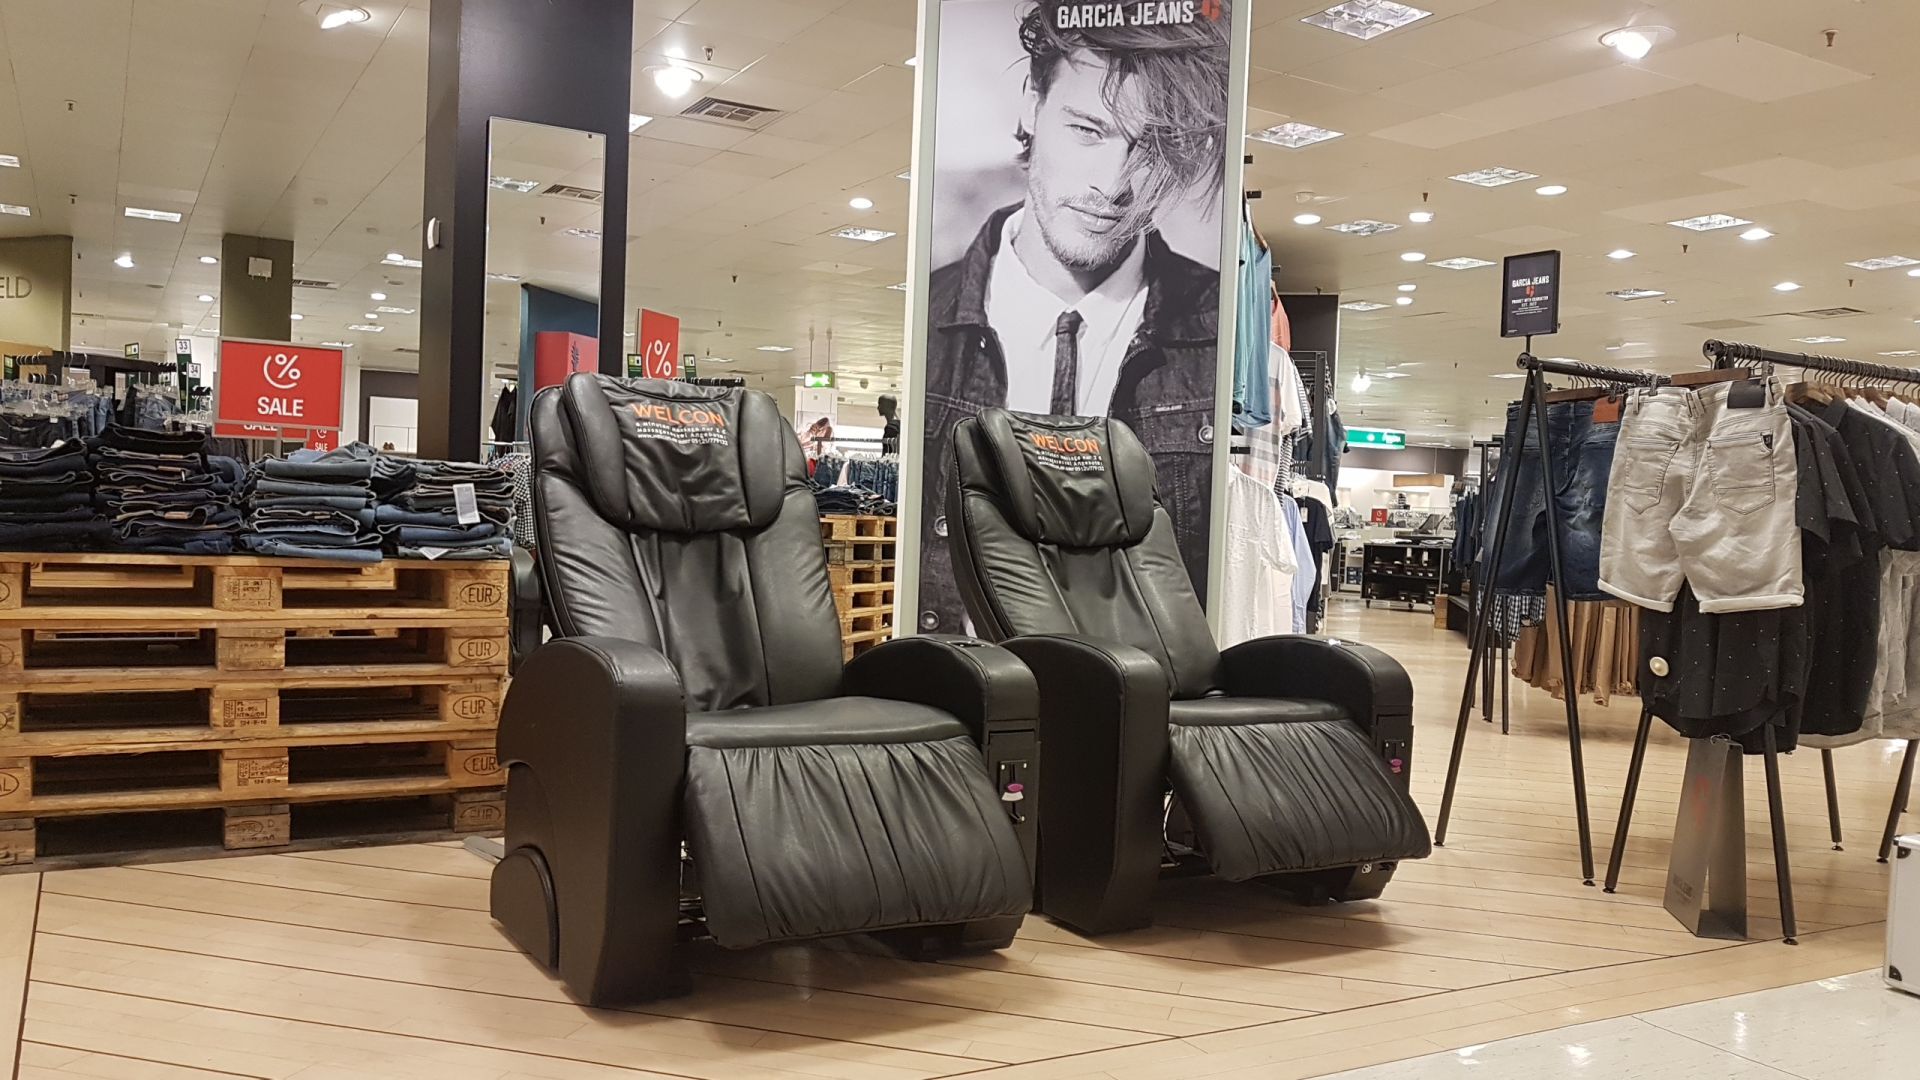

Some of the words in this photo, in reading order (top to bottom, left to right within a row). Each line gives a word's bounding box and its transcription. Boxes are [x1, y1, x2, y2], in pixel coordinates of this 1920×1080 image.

[1130, 0, 1195, 26] JEANS
[1512, 278, 1530, 288] GARCIA
[1532, 275, 1549, 285] JEANS
[178, 341, 188, 350] 33
[190, 365, 199, 374] 34
[257, 396, 304, 417] SALE
[630, 403, 725, 427] WELCON
[314, 442, 329, 453] SALE
[1029, 432, 1099, 454] WELCON
[467, 587, 494, 603] EUR
[466, 641, 492, 657] EUR
[460, 699, 486, 715] EUR
[472, 756, 497, 772] EUR
